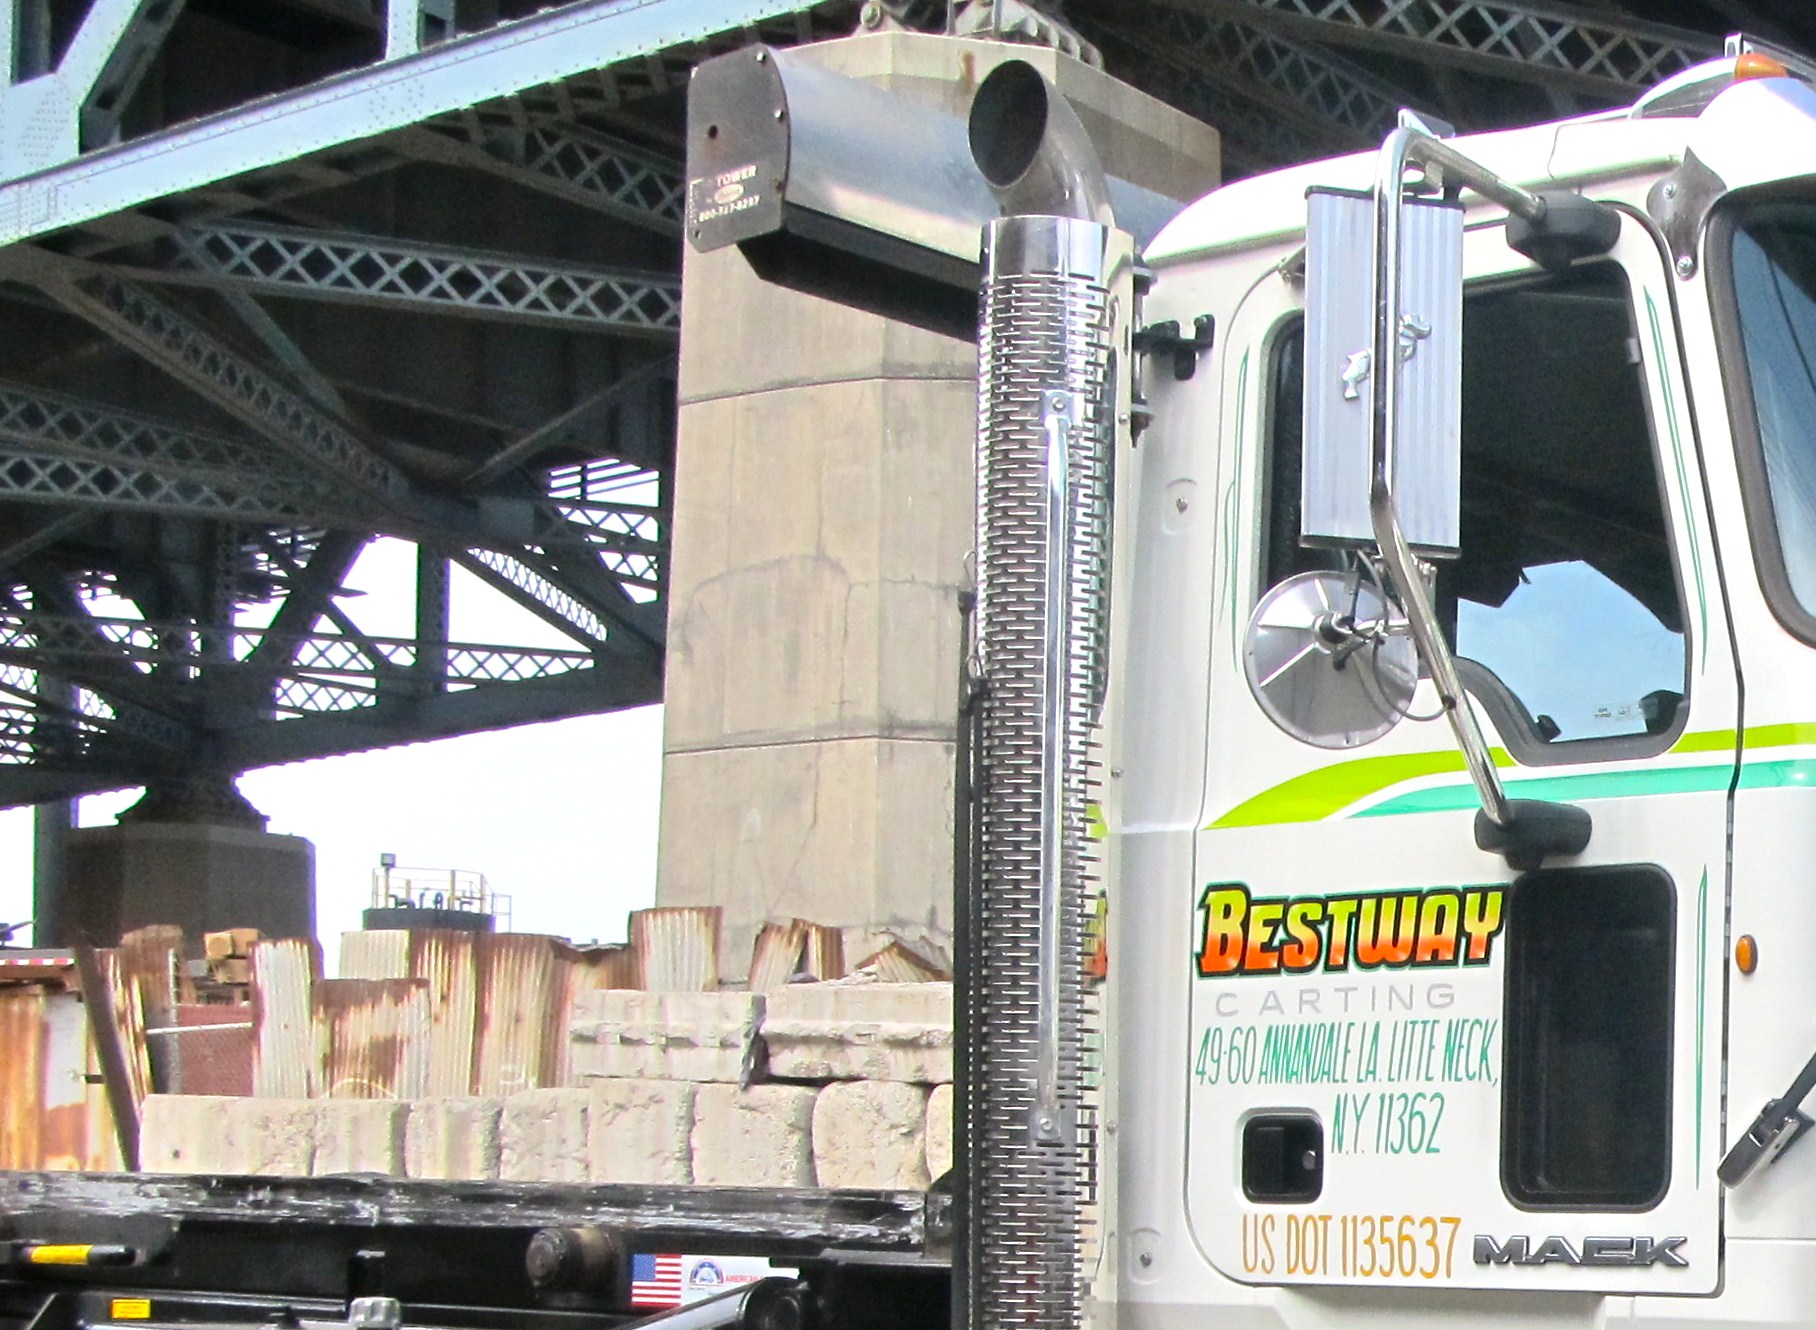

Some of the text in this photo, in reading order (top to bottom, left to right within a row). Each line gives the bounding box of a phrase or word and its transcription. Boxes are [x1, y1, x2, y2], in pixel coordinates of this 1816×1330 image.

[715, 164, 757, 187] TOWER
[1197, 883, 1510, 977] BESTWAY
[1215, 982, 1456, 1018] CARTING
[1195, 1025, 1257, 1085] 49-60
[1256, 1021, 1356, 1085] ANNANDALE
[1386, 1019, 1441, 1083] LITTE
[1441, 1018, 1499, 1088] NECK,
[1330, 1091, 1446, 1156] N.Y. 11362
[1241, 1213, 1462, 1279] US DOT 1135637
[1473, 1234, 1689, 1268] MACK
